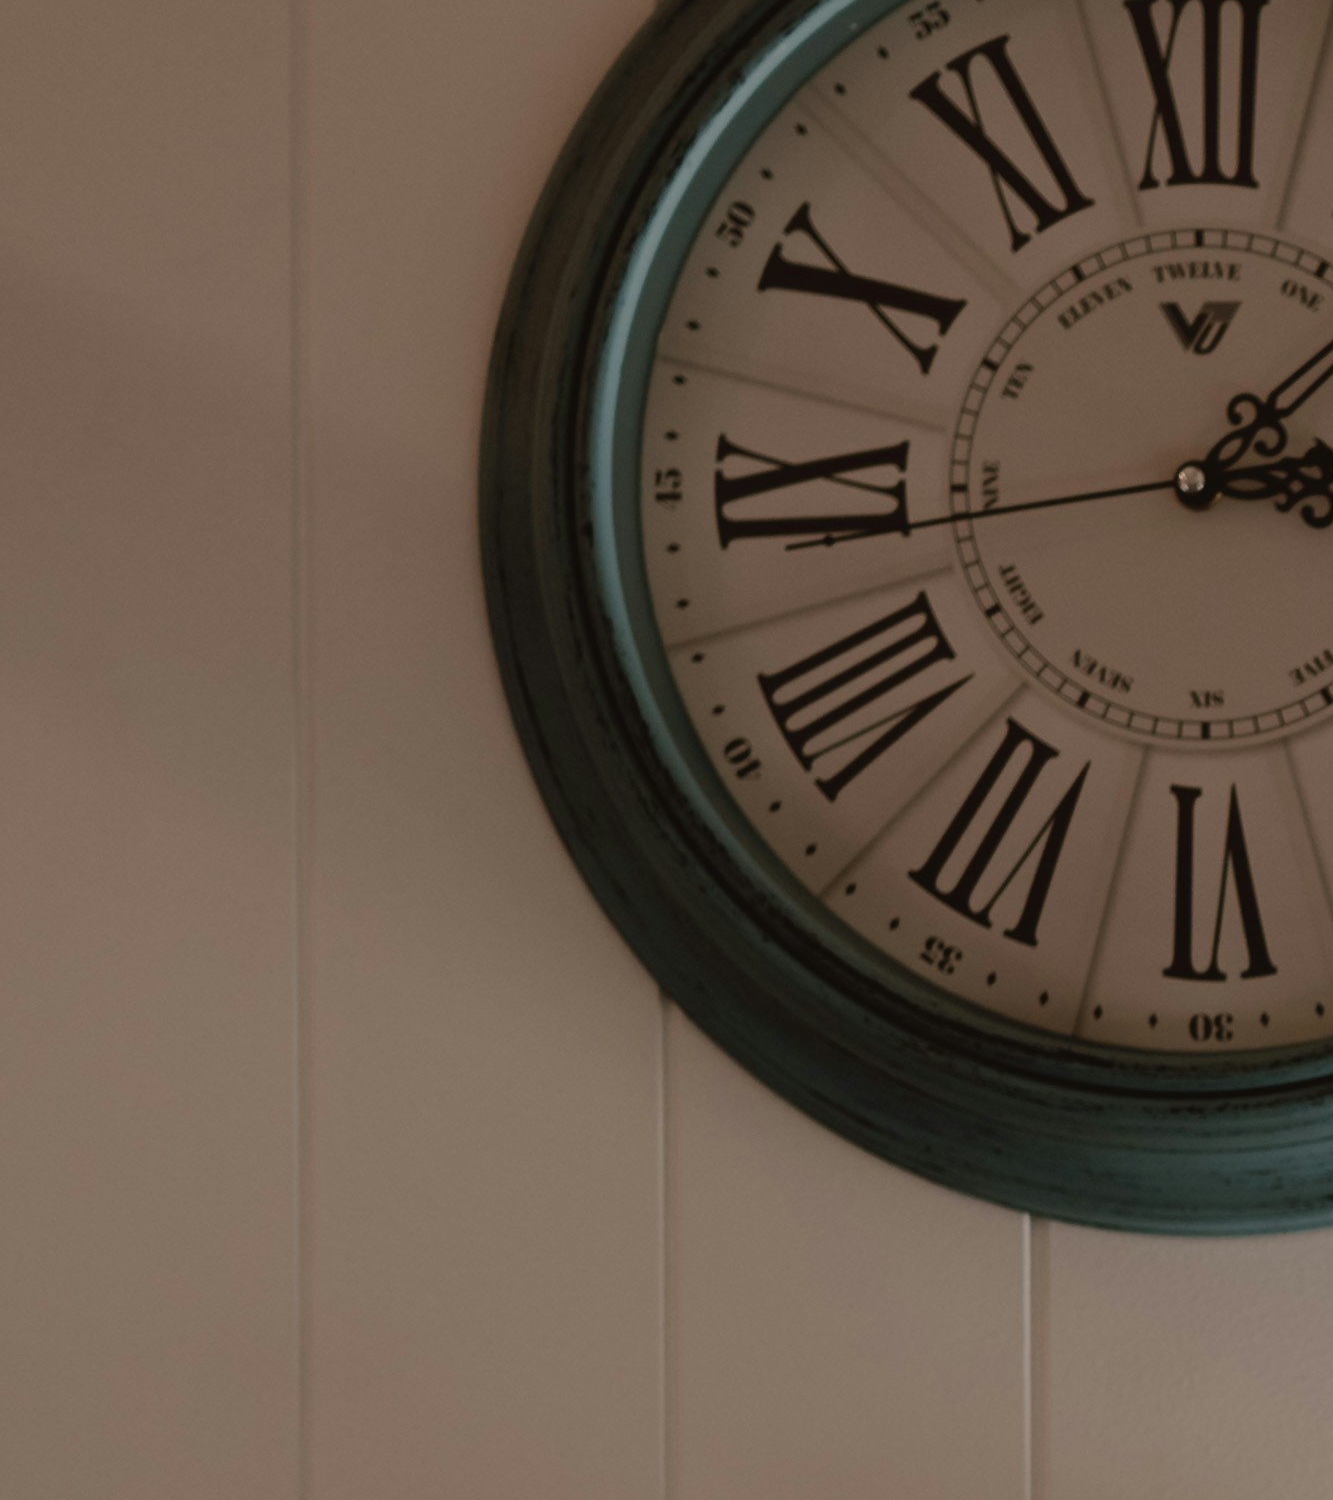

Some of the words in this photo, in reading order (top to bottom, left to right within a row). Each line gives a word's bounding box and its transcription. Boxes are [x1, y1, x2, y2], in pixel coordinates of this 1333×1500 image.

[907, 34, 1095, 253] XI
[714, 199, 758, 249] 50
[756, 201, 968, 375] X
[1152, 260, 1242, 285] TWELVE
[1280, 278, 1325, 313] ONE
[1057, 276, 1134, 331] ELEVEN
[1001, 360, 1035, 401] TEN
[653, 466, 684, 511] 45
[713, 432, 911, 551] IX
[981, 459, 1001, 510] NINE
[998, 563, 1045, 626] EIGHT
[1070, 648, 1134, 694] SEVEN
[757, 590, 977, 803] VIII
[1189, 690, 1226, 709] SIX
[721, 735, 763, 782] 40
[907, 716, 1092, 948] VII
[1162, 784, 1278, 983] VI
[917, 933, 965, 977] 35
[1187, 1014, 1235, 1043] 30
